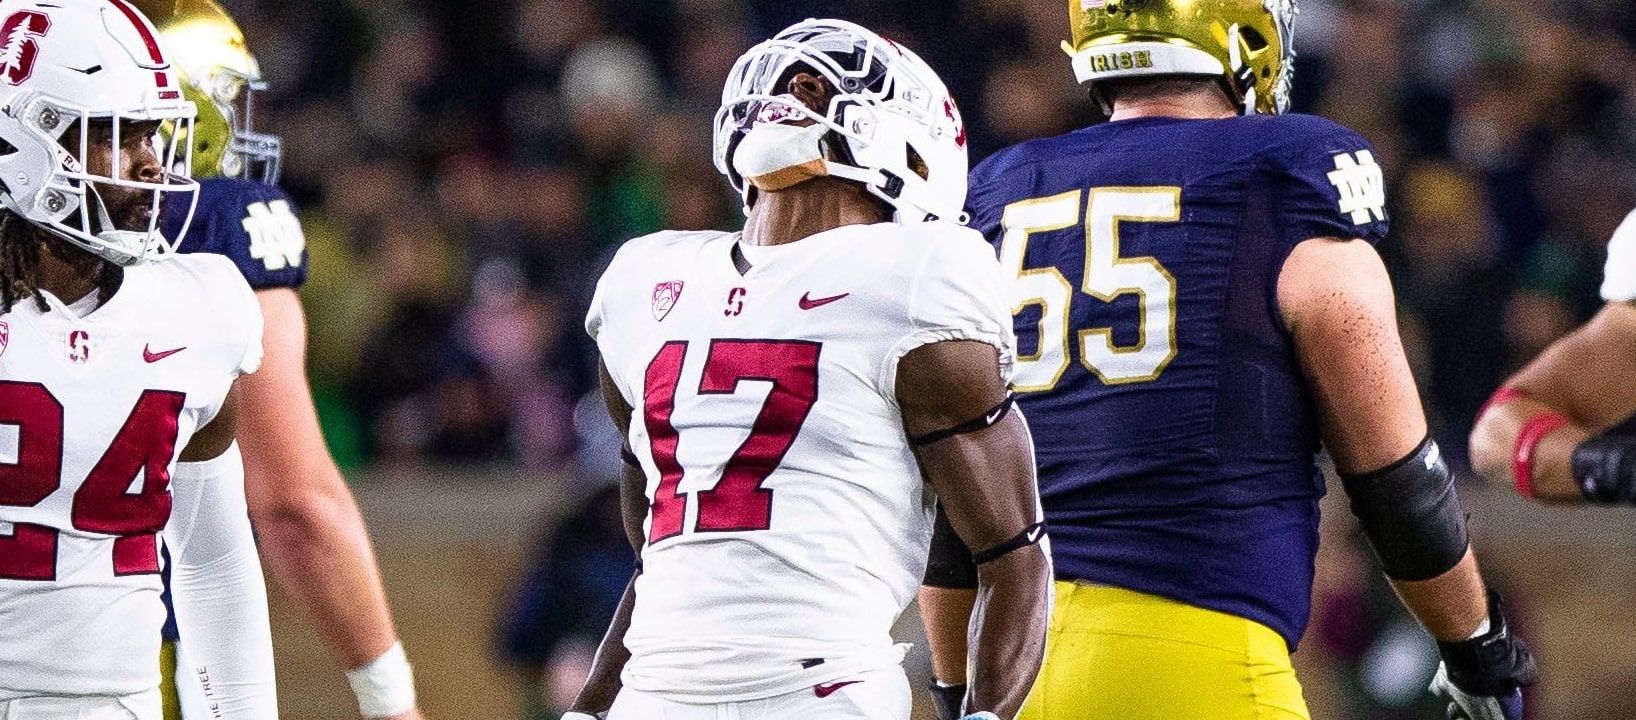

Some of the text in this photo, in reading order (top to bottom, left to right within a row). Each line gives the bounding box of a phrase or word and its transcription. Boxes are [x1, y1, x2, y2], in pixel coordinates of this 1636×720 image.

[1090, 50, 1153, 72] IRISH
[1000, 185, 1182, 393] 55
[0, 379, 187, 581] 24
[643, 338, 823, 546] 17
[196, 665, 213, 697] TREE
